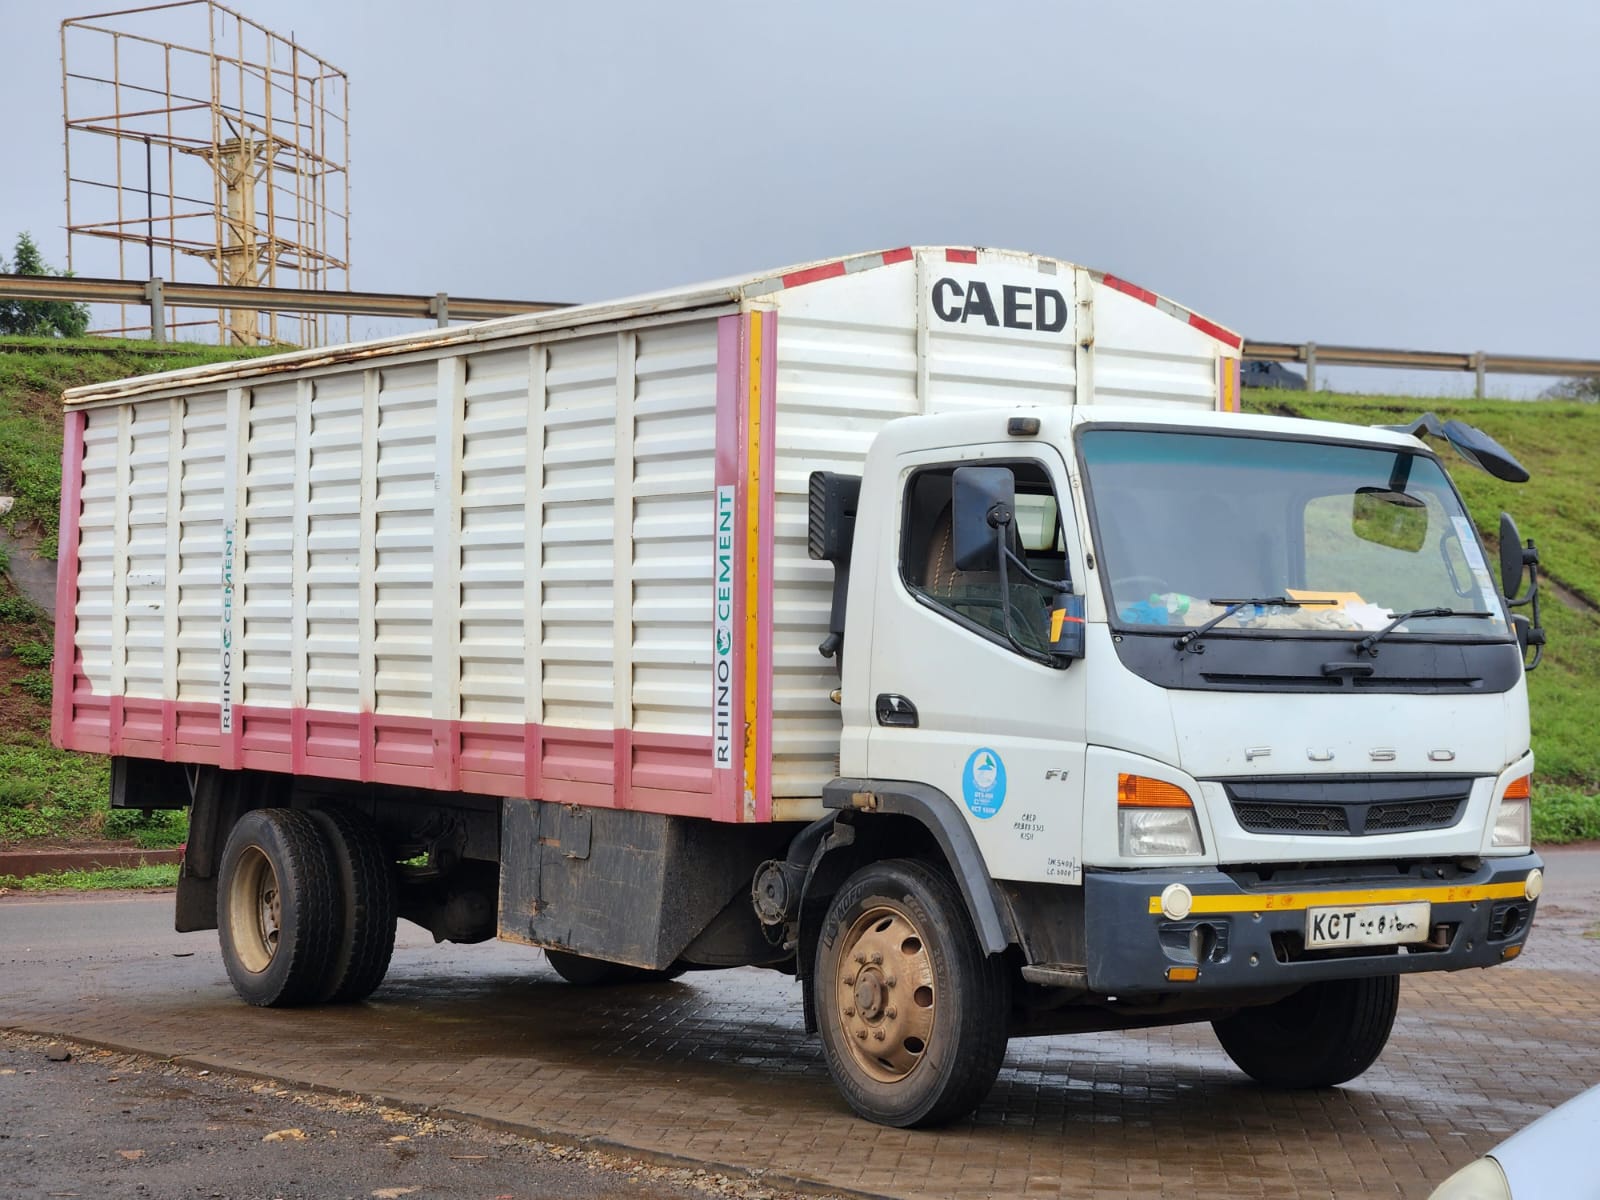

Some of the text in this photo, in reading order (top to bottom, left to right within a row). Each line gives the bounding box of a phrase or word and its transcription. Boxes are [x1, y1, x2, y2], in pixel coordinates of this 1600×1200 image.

[932, 277, 1068, 333] CAED
[224, 528, 233, 623] CEMENT
[717, 491, 732, 763] RHINO CEMENT
[1245, 746, 1456, 762] FUSO
[1313, 911, 1356, 941] KCT
